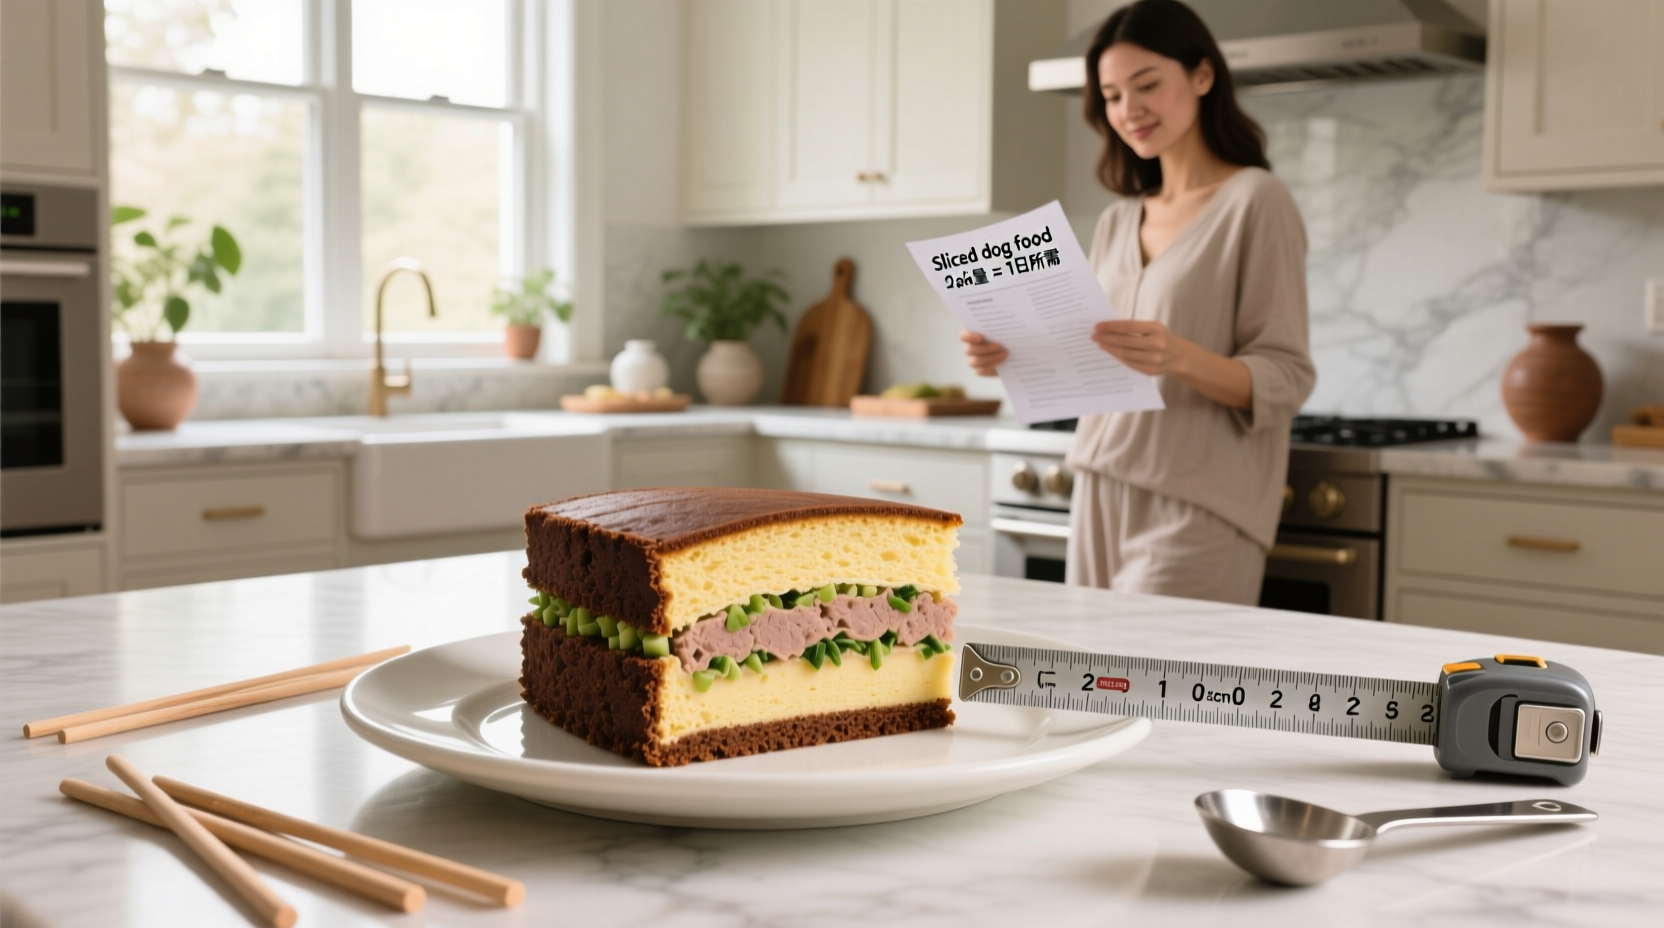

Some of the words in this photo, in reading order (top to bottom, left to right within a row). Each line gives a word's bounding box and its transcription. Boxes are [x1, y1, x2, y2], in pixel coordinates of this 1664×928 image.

[932, 247, 978, 271] Sliced
[982, 243, 1013, 259] dog
[1014, 226, 1052, 251] food
[1081, 673, 1095, 691] 2
[1270, 690, 1283, 709] 2
[1346, 697, 1361, 716] 2
